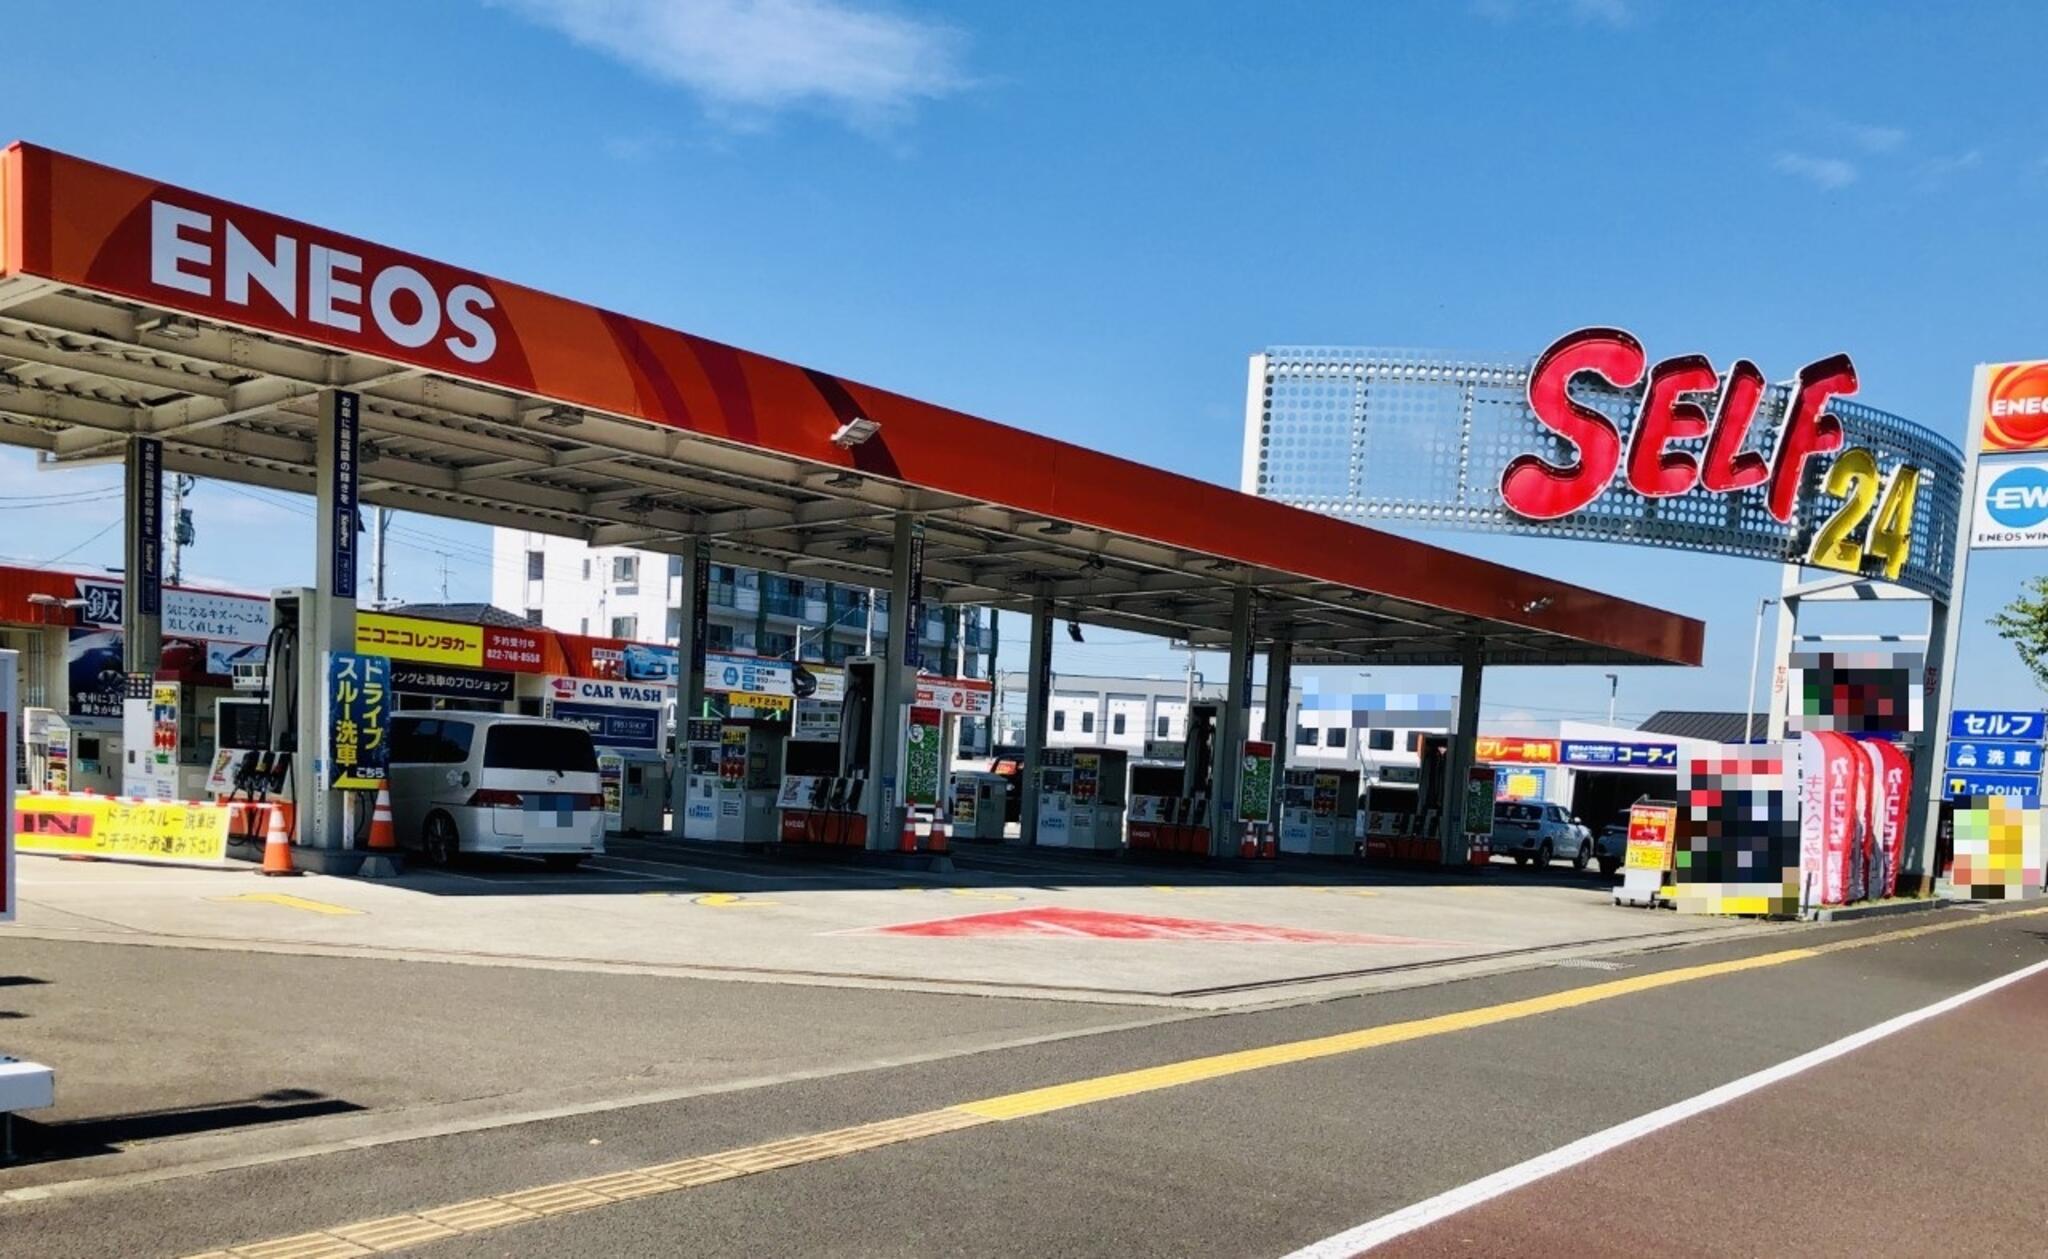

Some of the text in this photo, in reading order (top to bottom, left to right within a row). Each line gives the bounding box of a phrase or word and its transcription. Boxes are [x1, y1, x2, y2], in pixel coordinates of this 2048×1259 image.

[151, 199, 497, 363] ENEOS
[1500, 326, 1861, 524] SELF
[1809, 446, 1920, 582] 24
[1978, 532, 2022, 542] ENEOS
[88, 587, 120, 622] 鈑
[357, 626, 477, 651] ニコニコレンタカー
[363, 659, 384, 750] ドライブ
[582, 683, 662, 703] CAR WASH
[335, 657, 358, 767] スルー洗車
[1963, 713, 2033, 736] セルフ
[1617, 746, 1677, 764] コーティ
[1986, 749, 2032, 767] 洗車
[356, 766, 386, 779] こちら
[1969, 784, 2033, 796] T-POINT
[23, 813, 79, 834] IN
